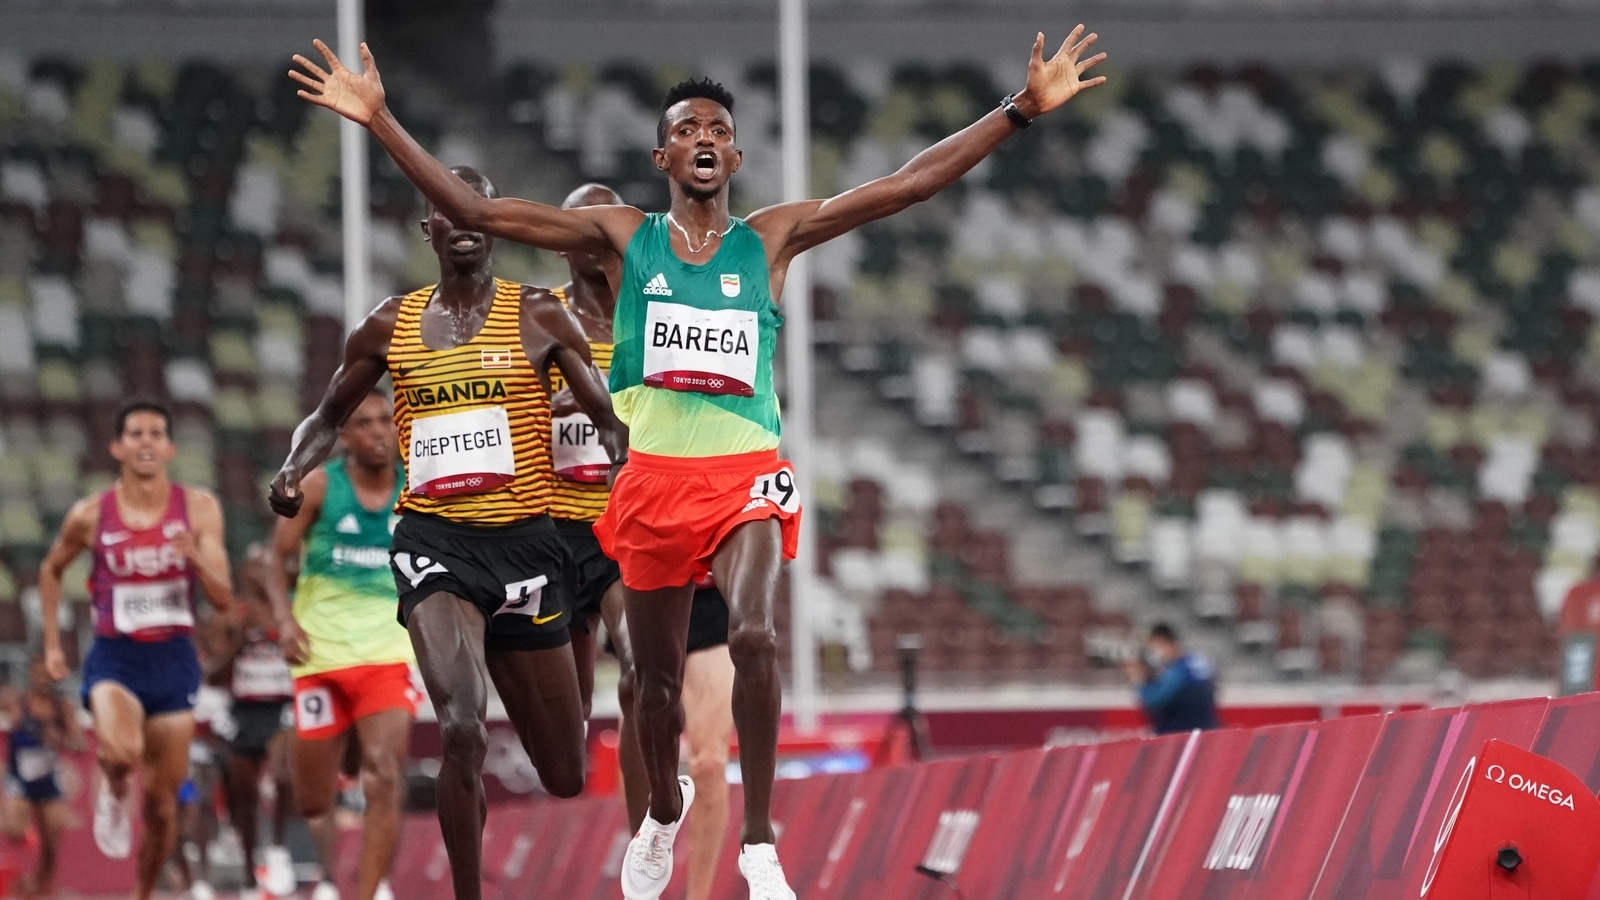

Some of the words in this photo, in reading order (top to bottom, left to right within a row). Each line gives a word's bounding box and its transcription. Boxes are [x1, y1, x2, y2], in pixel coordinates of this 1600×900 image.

[643, 286, 673, 297] adidas
[652, 321, 750, 356] BAREGA
[405, 380, 507, 408] UGANDA
[673, 376, 691, 384] TOKYO
[691, 378, 706, 386] 2020
[414, 428, 502, 458] CHEPTEGEI
[559, 422, 602, 446] KIP
[105, 546, 186, 577] USA
[303, 695, 323, 723] 9
[1508, 773, 1575, 812] OMEGA
